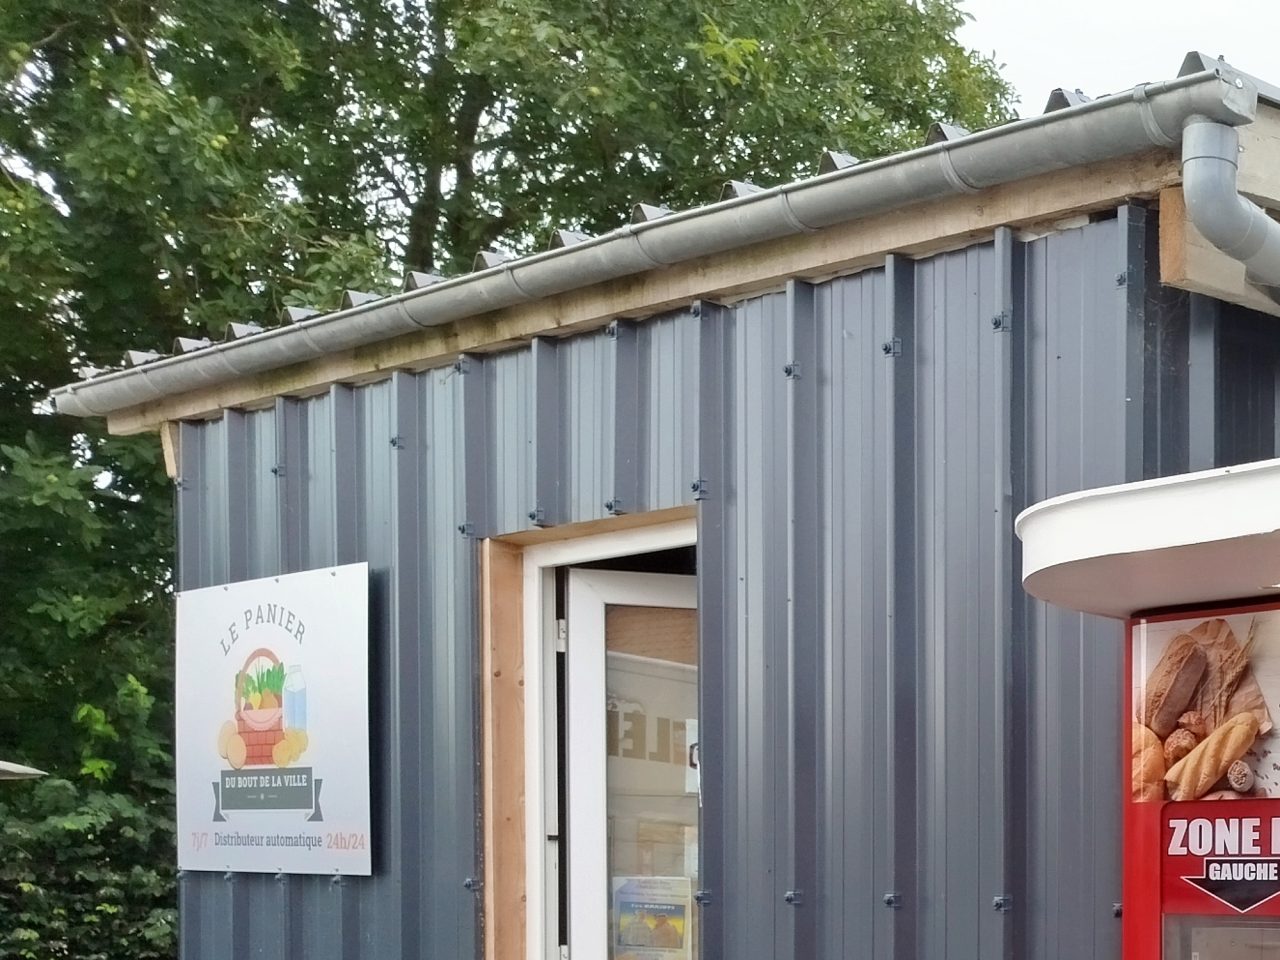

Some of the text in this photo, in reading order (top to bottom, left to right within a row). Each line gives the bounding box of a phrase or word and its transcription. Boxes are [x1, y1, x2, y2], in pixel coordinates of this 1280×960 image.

[220, 603, 305, 656] LE PANIER
[225, 775, 307, 788] DU BOUT DE LA VILLE
[214, 832, 263, 847] Distributeur
[266, 832, 322, 850] automatique
[327, 832, 365, 850] 24h/24
[1167, 817, 1260, 856] ZONE
[1208, 862, 1279, 881] GAUCHE
